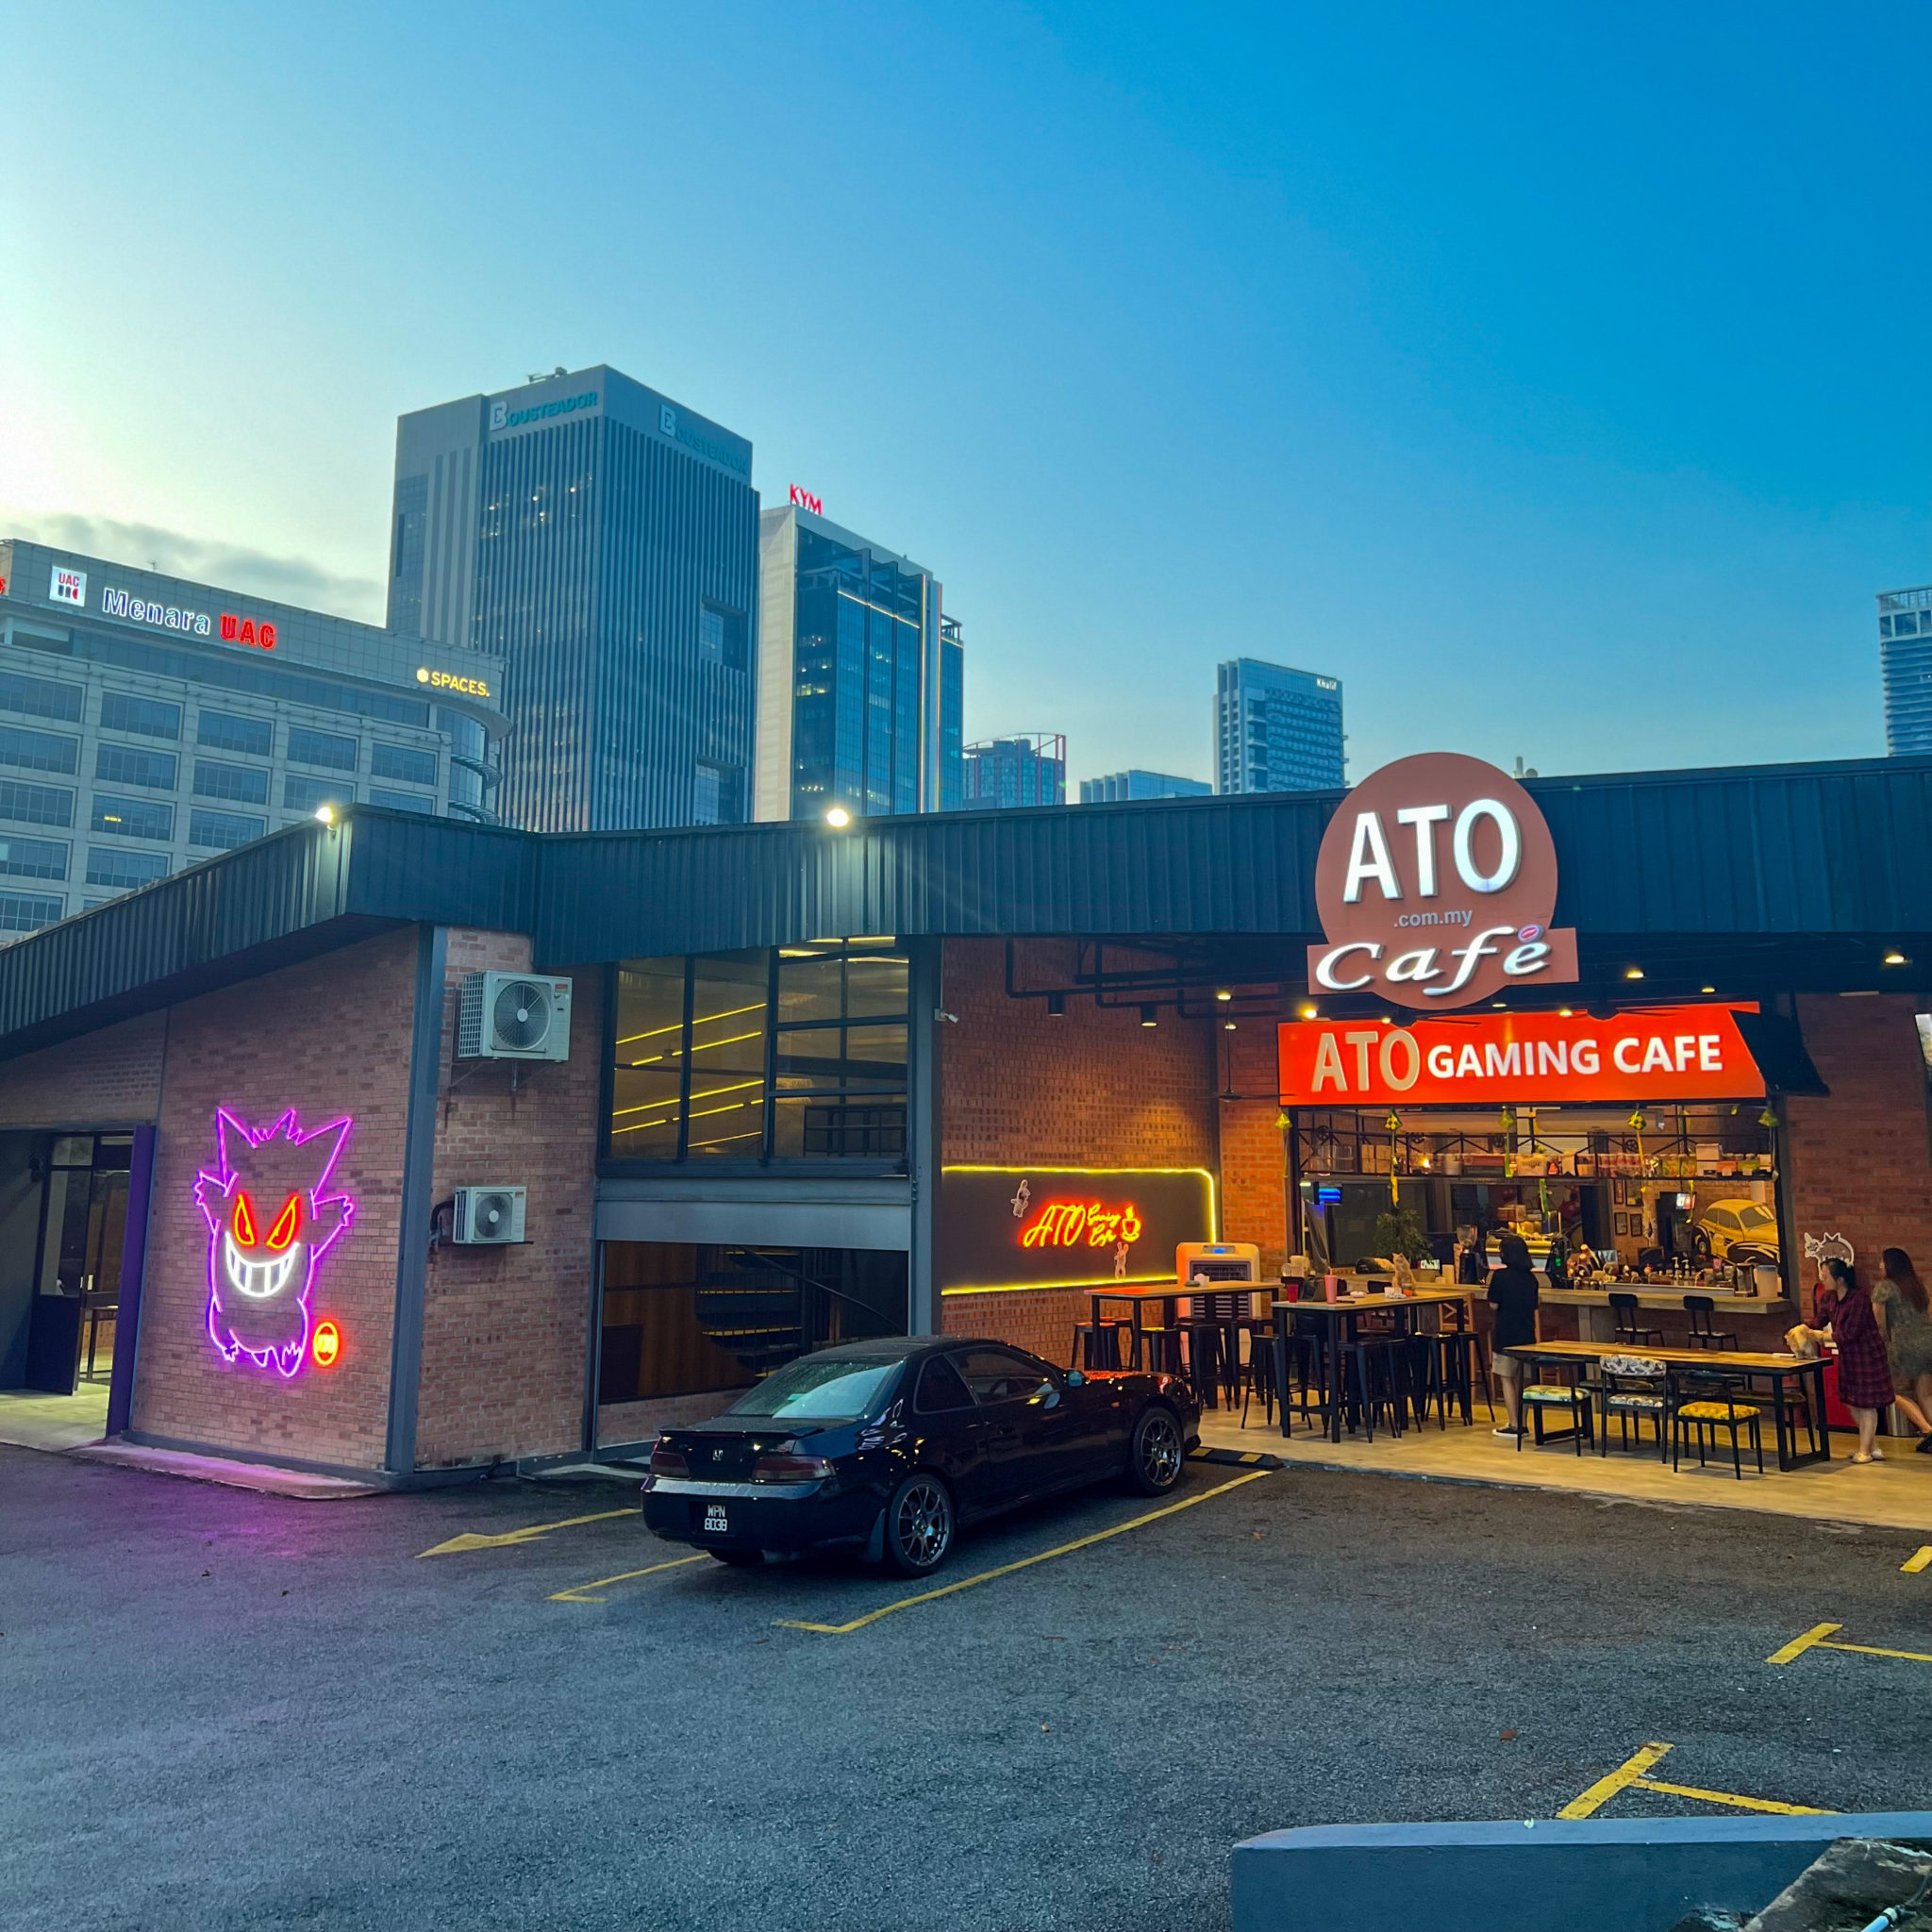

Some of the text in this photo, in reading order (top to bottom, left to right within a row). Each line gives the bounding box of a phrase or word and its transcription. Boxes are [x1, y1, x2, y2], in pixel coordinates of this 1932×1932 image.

[790, 483, 822, 515] KYM
[58, 573, 79, 587] UAC
[103, 587, 276, 650] Menara UAC
[1343, 798, 1522, 903] ATO
[1393, 908, 1473, 929] .com.my
[1311, 1030, 1723, 1092] ATO GAMING CAFE
[1024, 1205, 1086, 1246] ATO
[708, 1505, 725, 1517] WPN
